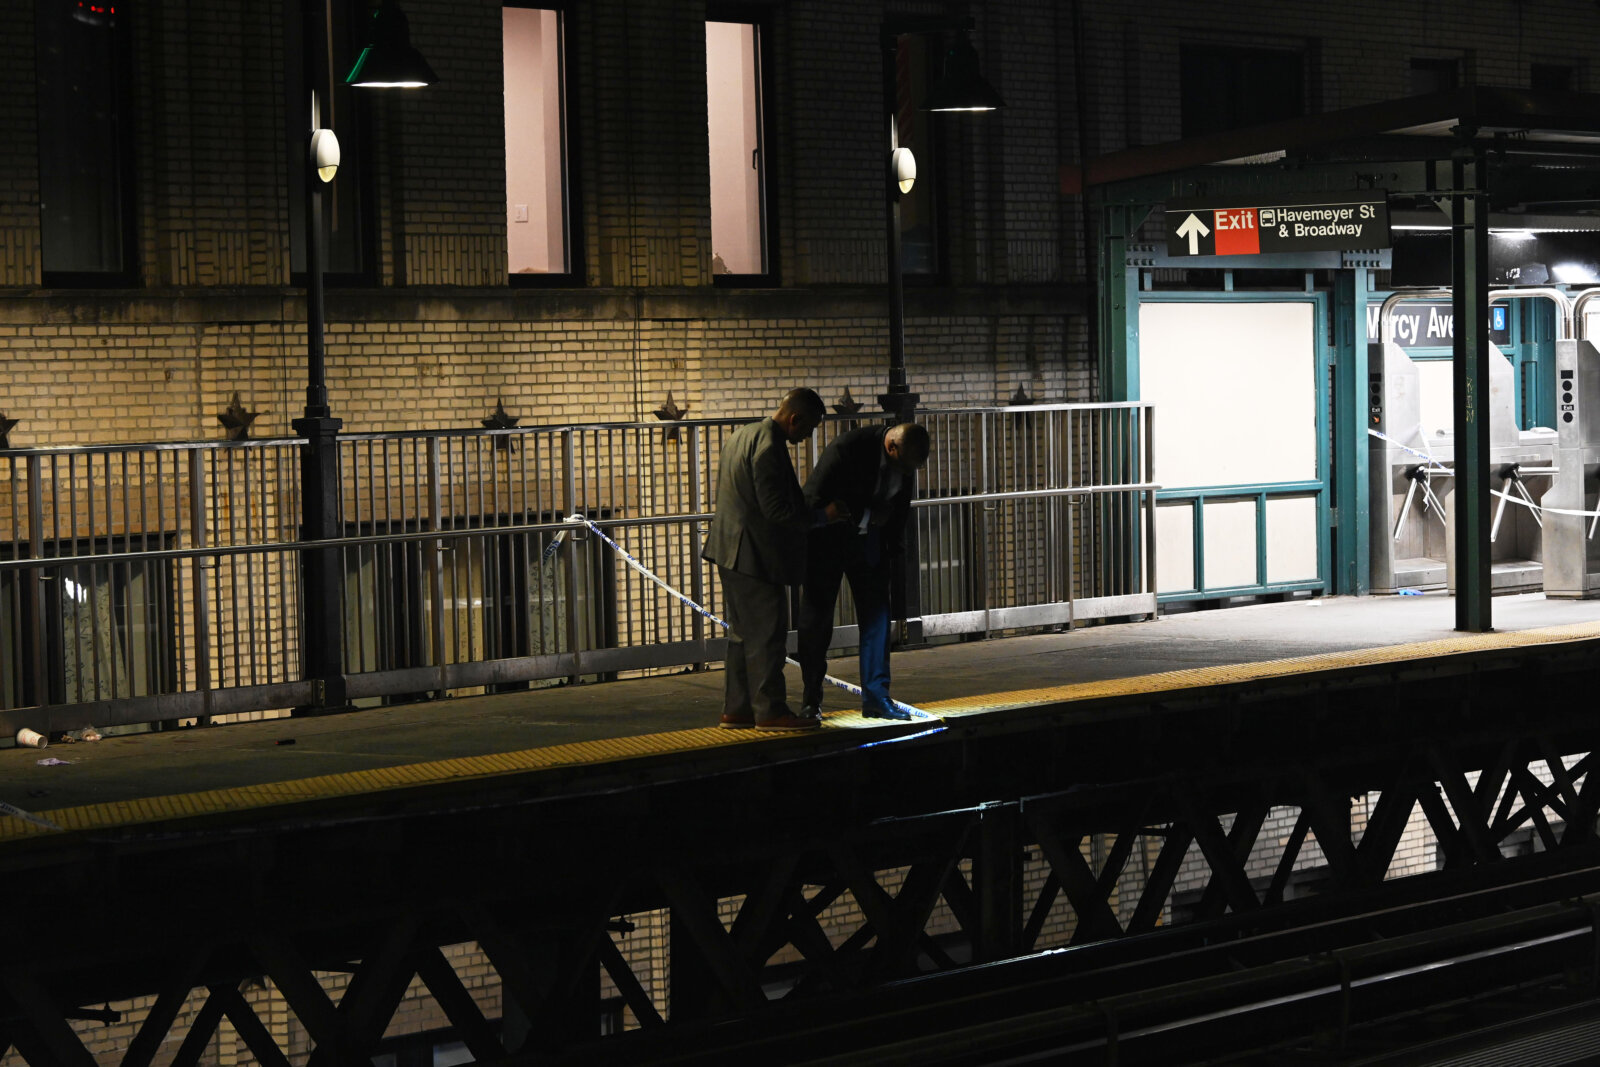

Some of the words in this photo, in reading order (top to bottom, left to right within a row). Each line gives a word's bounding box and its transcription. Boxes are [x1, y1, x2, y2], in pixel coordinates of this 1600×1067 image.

[1215, 210, 1254, 230] Exit
[1277, 208, 1354, 224] Havemeyer
[1359, 204, 1376, 219] St
[1278, 225, 1289, 238] &
[1294, 221, 1363, 238] Broadway
[1366, 306, 1420, 345] Mrcy
